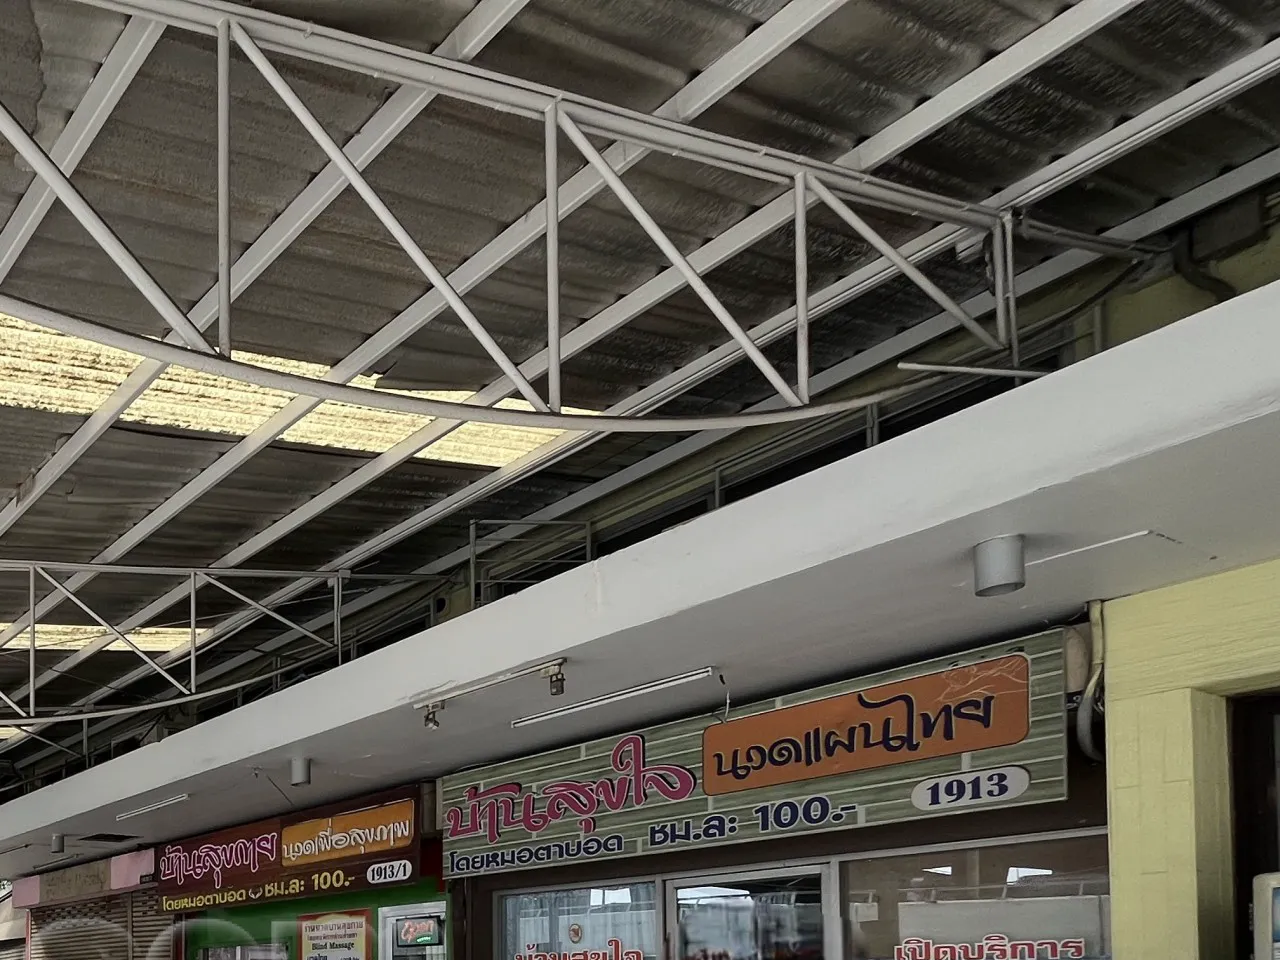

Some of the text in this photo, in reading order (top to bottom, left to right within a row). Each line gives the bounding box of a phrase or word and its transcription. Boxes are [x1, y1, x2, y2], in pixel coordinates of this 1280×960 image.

[712, 691, 995, 780] นวดแผนไทย
[446, 734, 697, 844] บ้านสุขใจ
[926, 771, 1010, 807] 1913
[160, 832, 278, 889] บ้านสุขกาย
[282, 818, 410, 862] นวดเพื่อสุขภาพ
[449, 834, 623, 874] โดยหมอตาบอด
[648, 814, 738, 847] ชม.ละ
[162, 888, 247, 911] โดยหมอตาบอด
[264, 877, 306, 898] ชม.ละ
[369, 862, 408, 882] 1913/1
[329, 941, 355, 951] Massage
